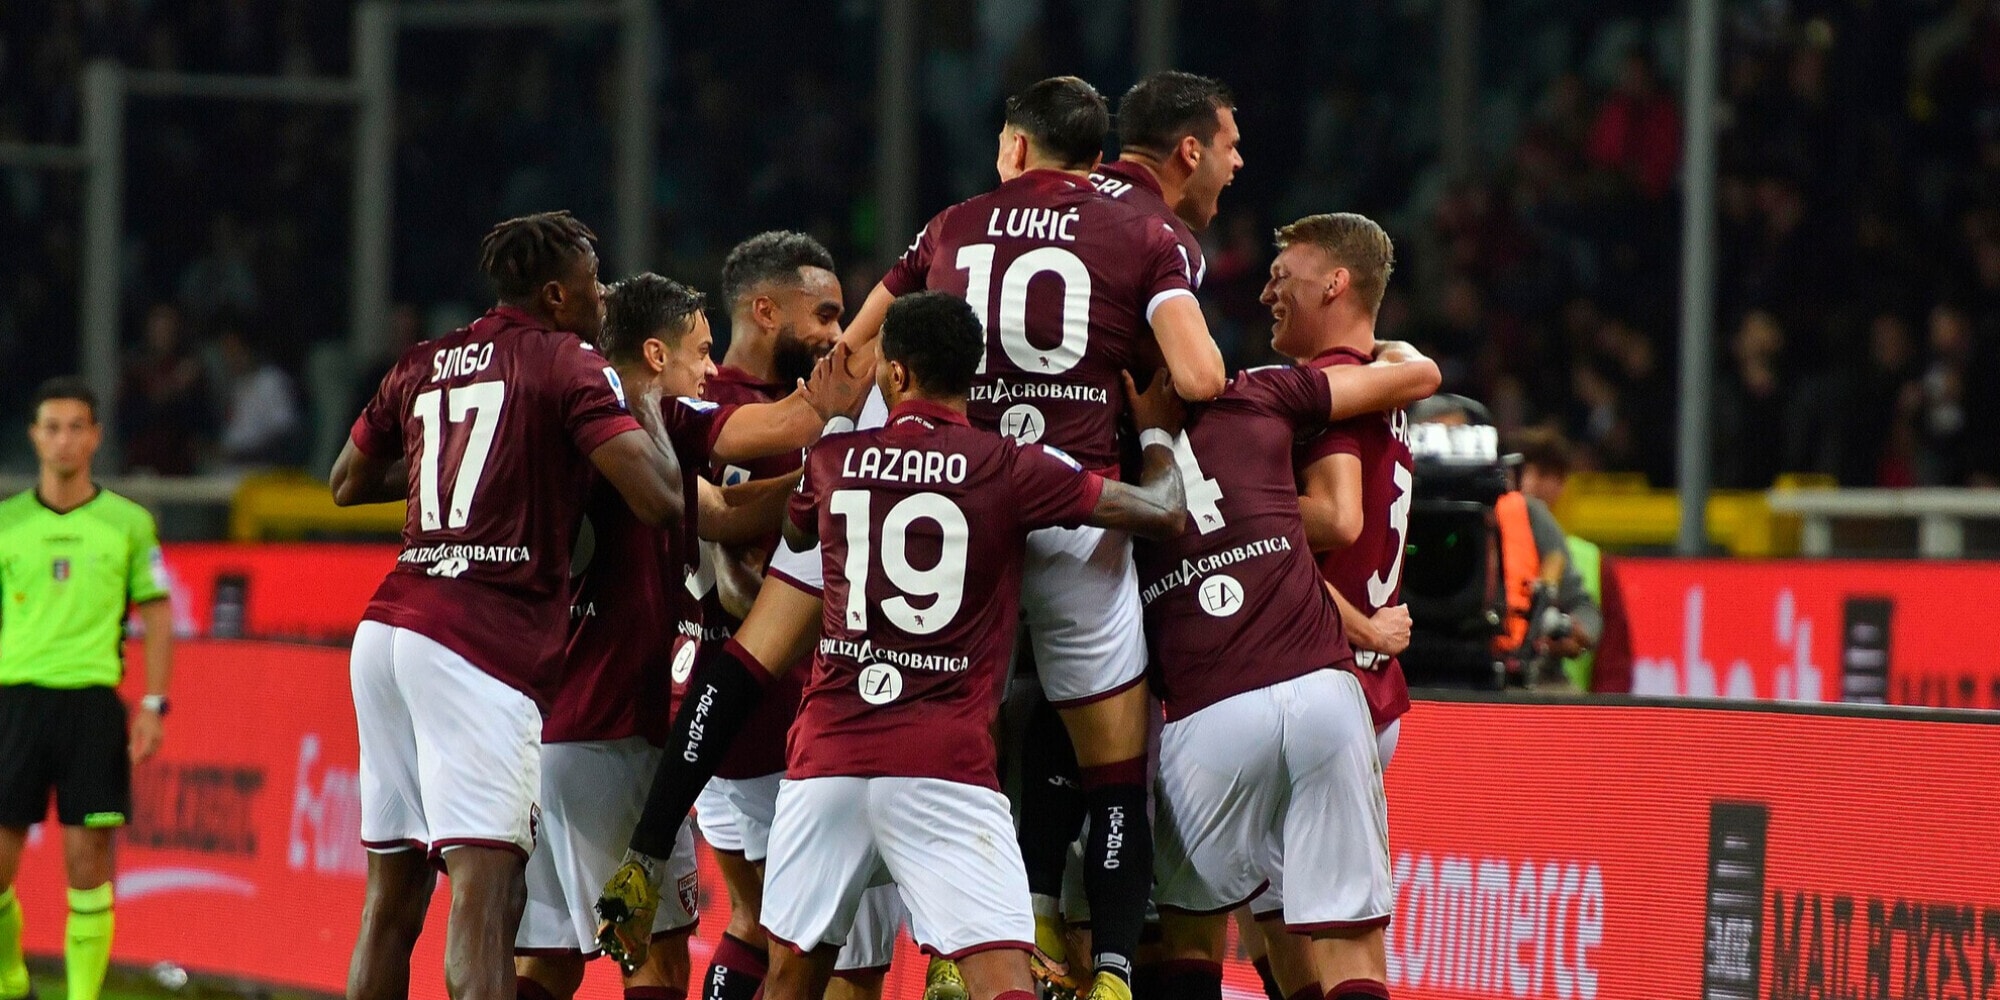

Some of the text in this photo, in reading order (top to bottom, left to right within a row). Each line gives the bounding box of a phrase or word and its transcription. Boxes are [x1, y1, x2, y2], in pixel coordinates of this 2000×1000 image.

[988, 207, 1080, 241] LUKIĆ
[955, 243, 1092, 375] 10
[431, 341, 494, 383] SINGO
[967, 377, 1108, 404] IZIACROBATICA
[413, 380, 505, 531] 17
[842, 447, 967, 484] LAZARO
[829, 489, 969, 635] 19
[1142, 536, 1292, 608] DILIZIACROBATICA
[1203, 581, 1241, 612] EA
[819, 639, 969, 671] EDILIZIACROBATICA
[864, 669, 894, 699] EA
